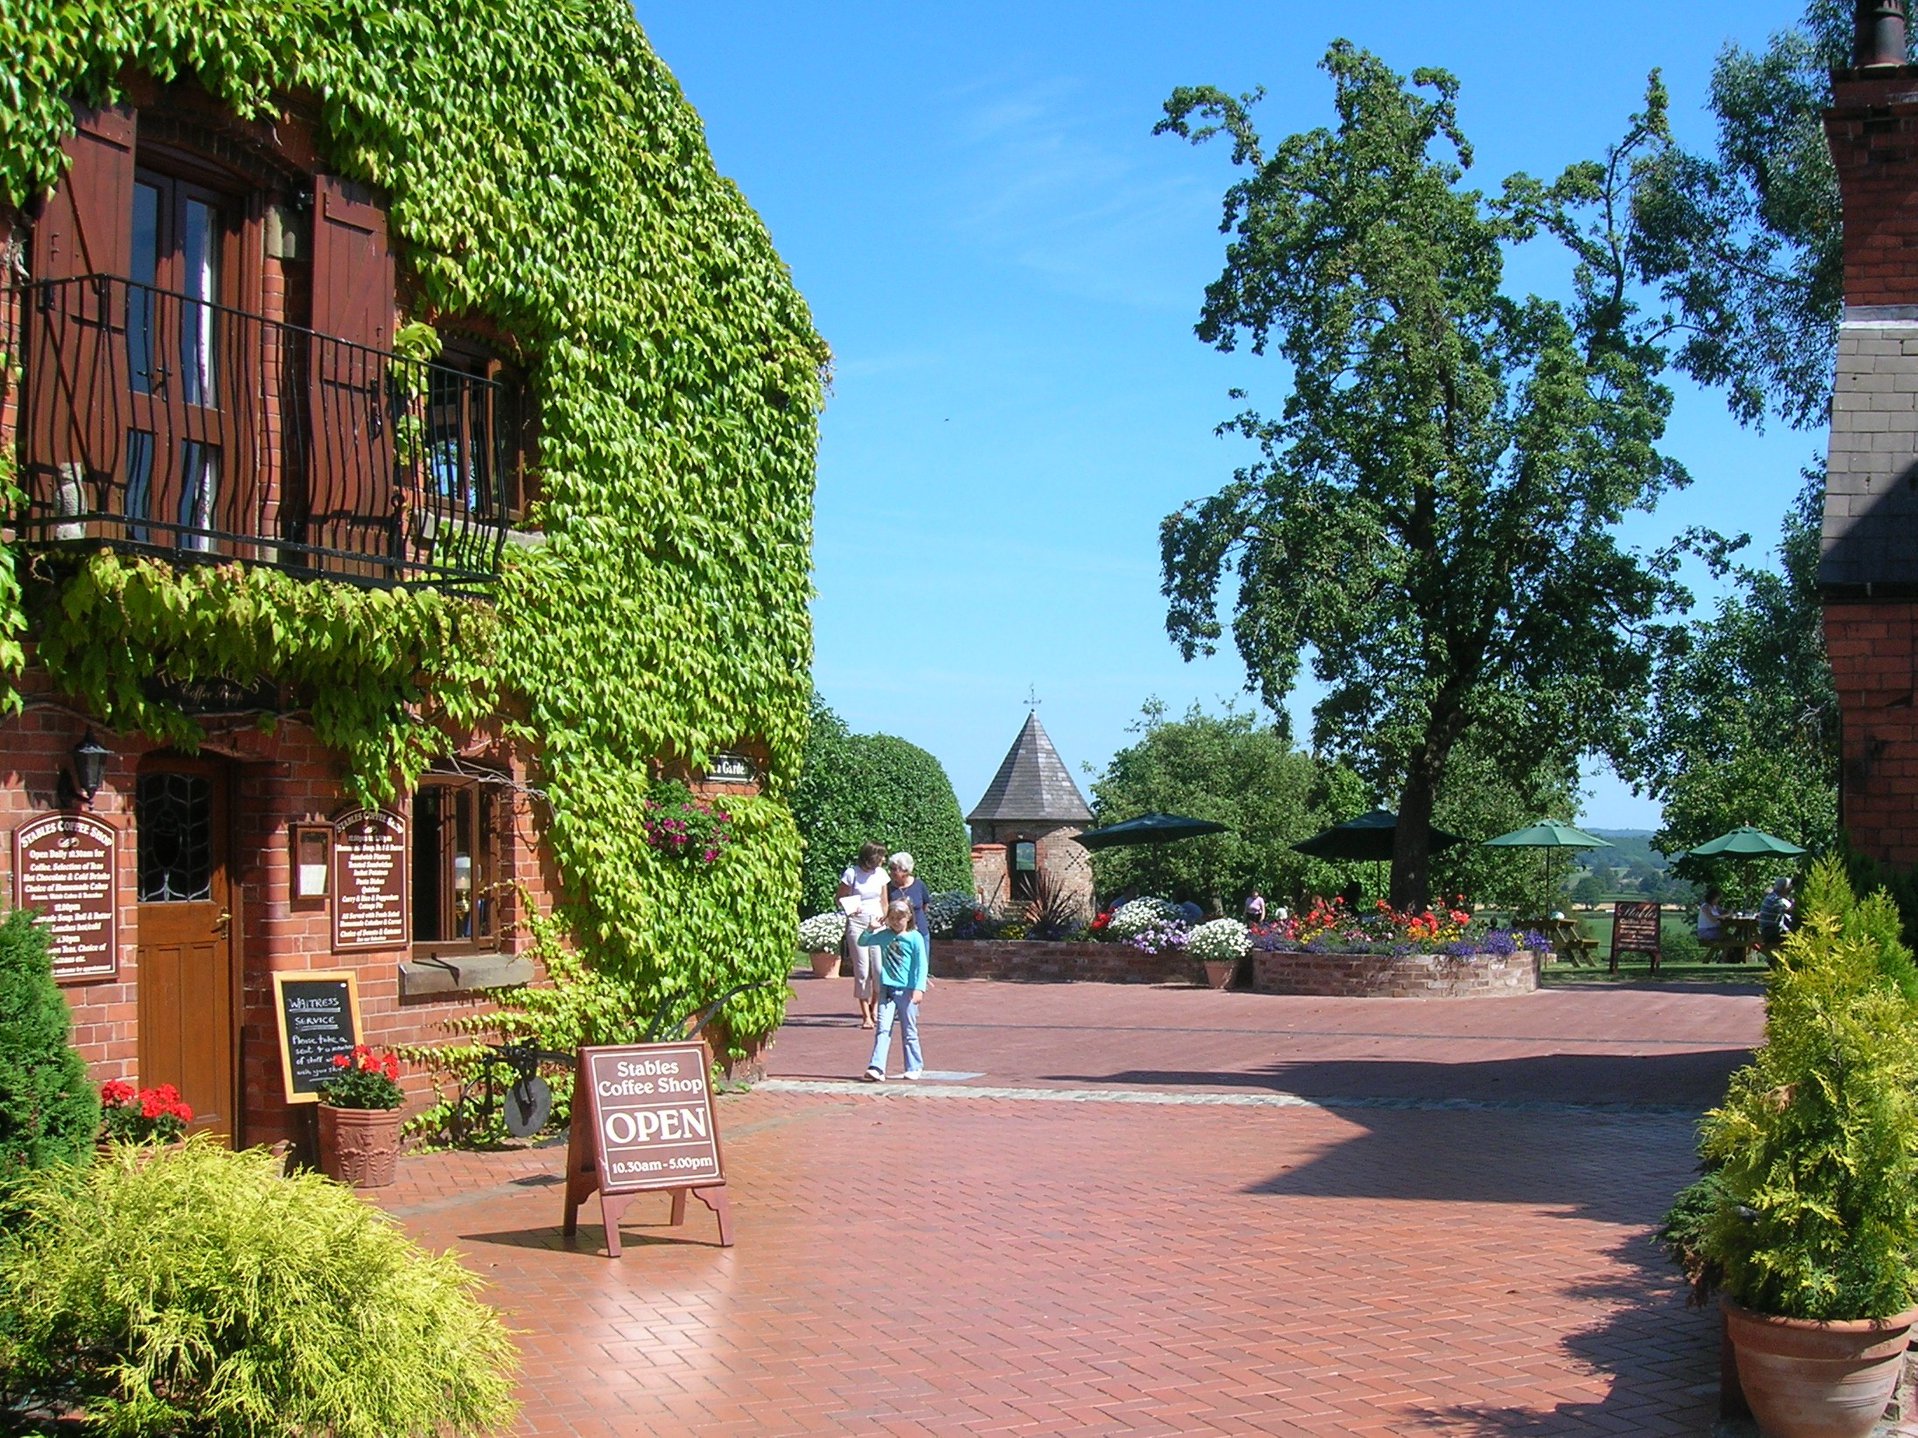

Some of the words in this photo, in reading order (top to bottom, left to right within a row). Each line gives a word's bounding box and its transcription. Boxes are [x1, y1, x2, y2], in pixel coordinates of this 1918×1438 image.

[21, 823, 57, 848] STABLES
[57, 821, 90, 834] COFFEE
[90, 827, 112, 846] SHOP
[29, 850, 48, 860] Open
[48, 850, 67, 860] Daily
[94, 849, 105, 858] for
[81, 862, 91, 870] of
[36, 874, 67, 882] Chocolate
[67, 873, 73, 881] &
[24, 885, 46, 893] Choice
[47, 884, 55, 892] of
[87, 912, 93, 921] &
[99, 943, 107, 951] of
[288, 997, 340, 1009] WAITRESS
[295, 1016, 336, 1026] SERVICE
[617, 1061, 680, 1077] Stables
[598, 1080, 654, 1097] Coffee
[657, 1077, 703, 1094] Shop
[605, 1107, 707, 1144] OPEN
